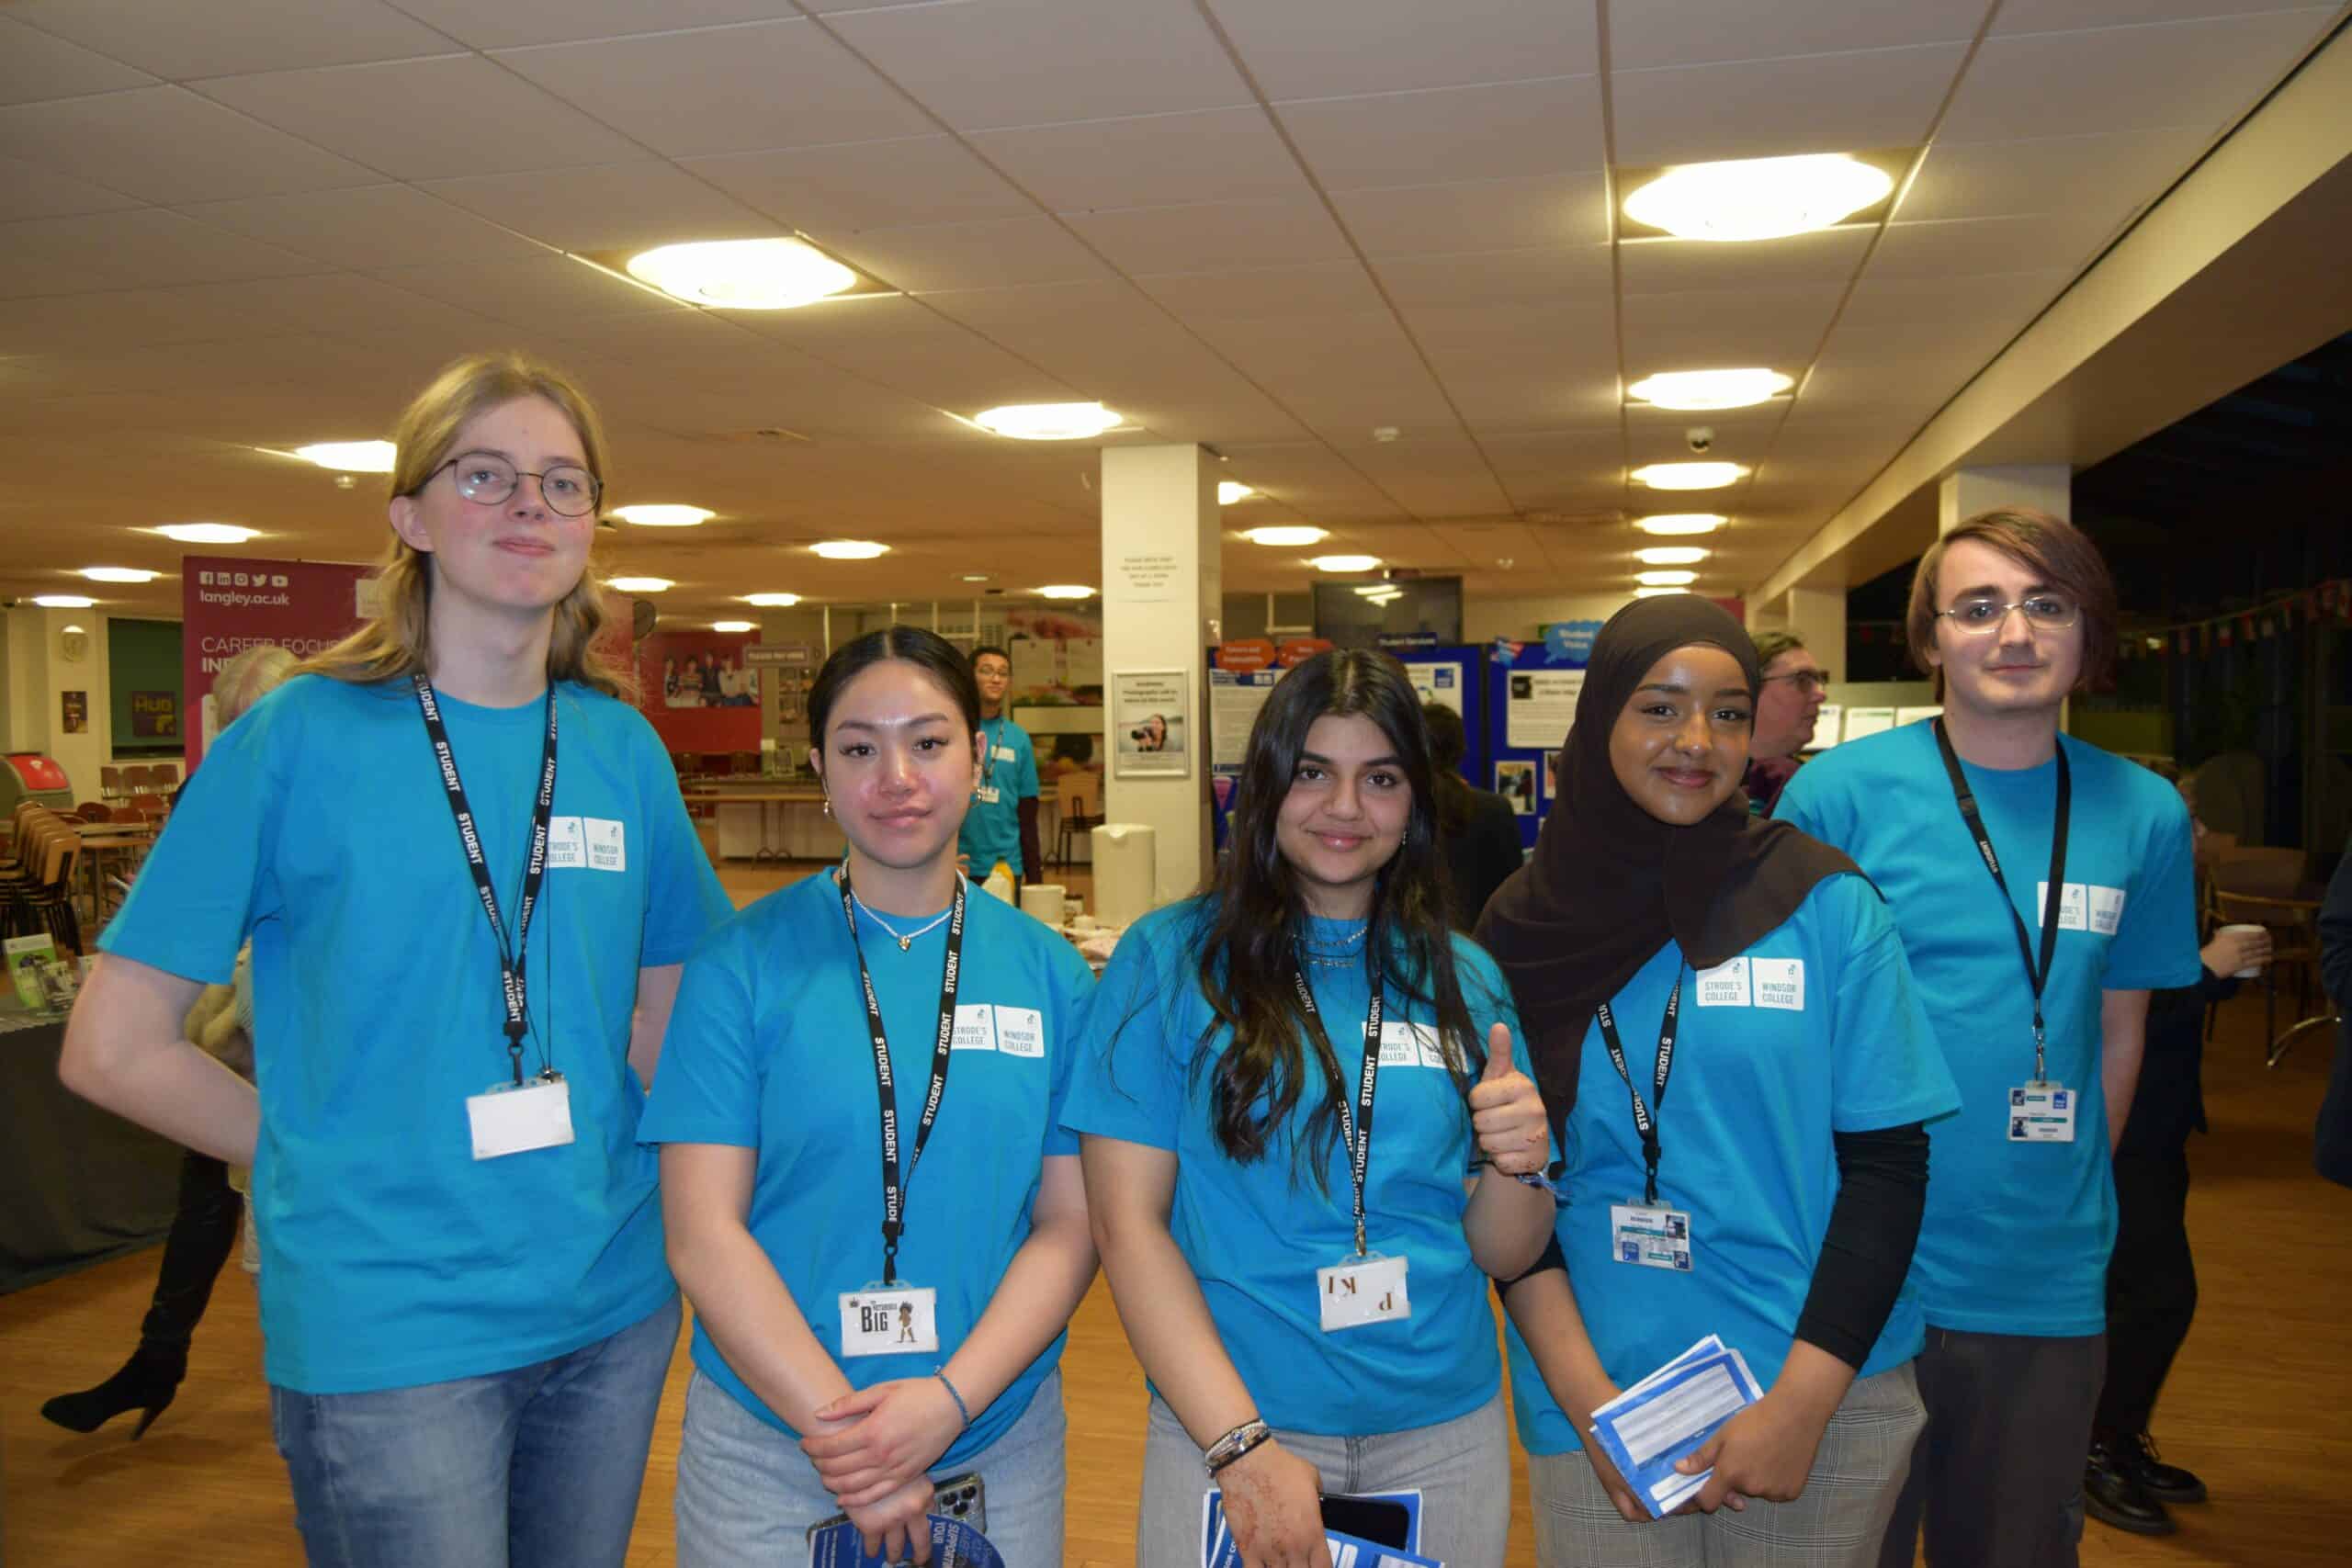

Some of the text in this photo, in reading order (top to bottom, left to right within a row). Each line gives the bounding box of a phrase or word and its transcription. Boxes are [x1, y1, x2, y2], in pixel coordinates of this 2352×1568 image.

[199, 590, 290, 607] langley.ac.uk
[435, 741, 461, 793] STUDENT
[539, 757, 557, 807] STUDENT
[458, 812, 483, 864] STUDENT
[529, 824, 548, 874] STUDENT
[952, 892, 965, 935] STUDENT
[503, 971, 522, 1022] STUDENT
[944, 950, 959, 994] STUDENT
[1295, 972, 1317, 1014] STUDENT
[1704, 991, 1738, 1001] COLLEGE
[1762, 982, 1797, 993] WINDSOR
[1368, 995, 1381, 1037] STUDENT
[1762, 992, 1794, 1005] COLLEGE
[938, 1011, 953, 1056] STUDENT
[875, 1037, 892, 1088] STUDENT
[1362, 1054, 1376, 1107] STUDENT
[1656, 1036, 1673, 1088] STUDENT
[922, 1073, 944, 1126] STUDENT
[883, 1110, 898, 1164] STUDENT
[1355, 1128, 1368, 1183] STUDENT
[861, 1305, 889, 1333] BIG
